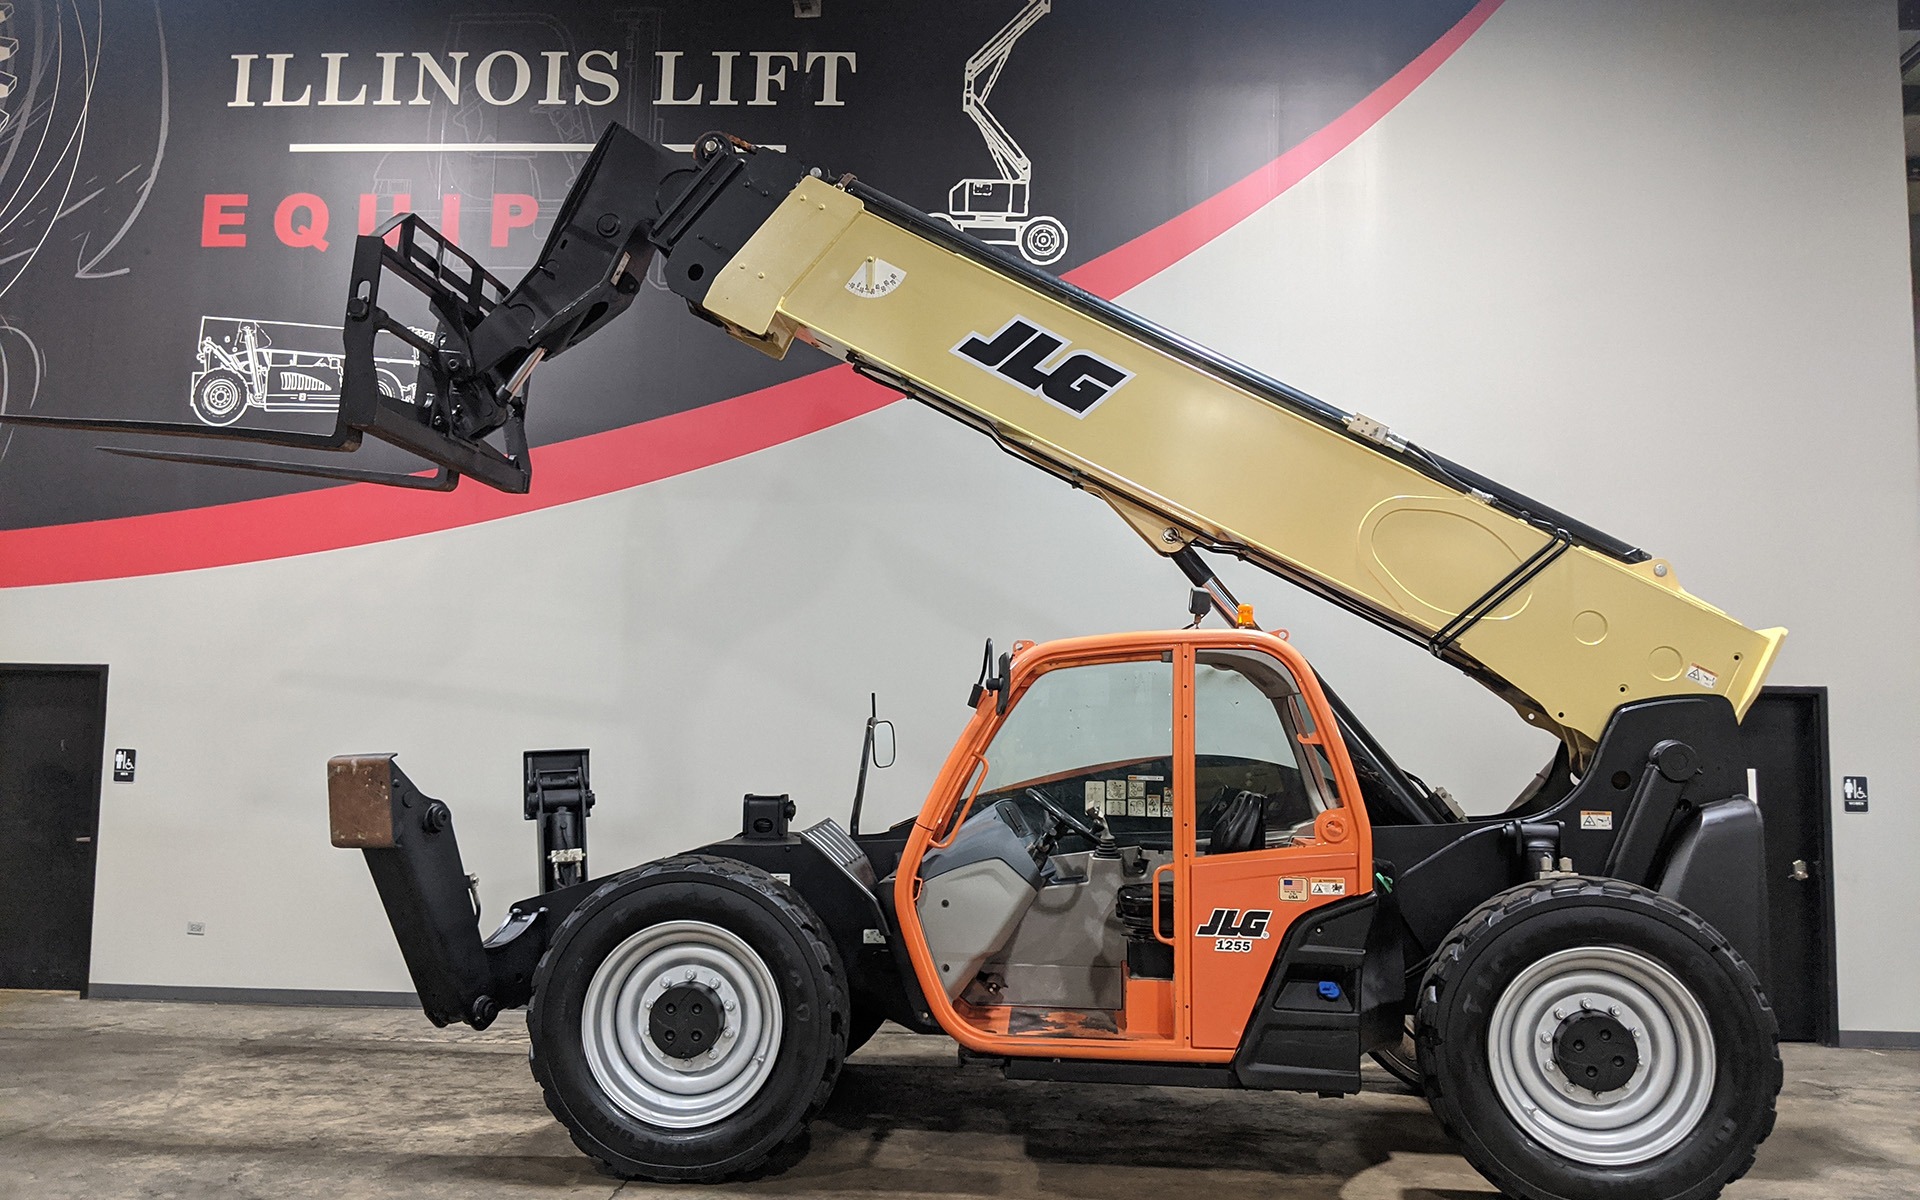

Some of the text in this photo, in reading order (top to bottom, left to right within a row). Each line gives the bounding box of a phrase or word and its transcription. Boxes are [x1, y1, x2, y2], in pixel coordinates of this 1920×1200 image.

[228, 50, 857, 107] ILLINOIS LIFT
[954, 317, 1130, 415] JLG
[1196, 909, 1271, 938] JLG
[1216, 940, 1251, 951] 1255
